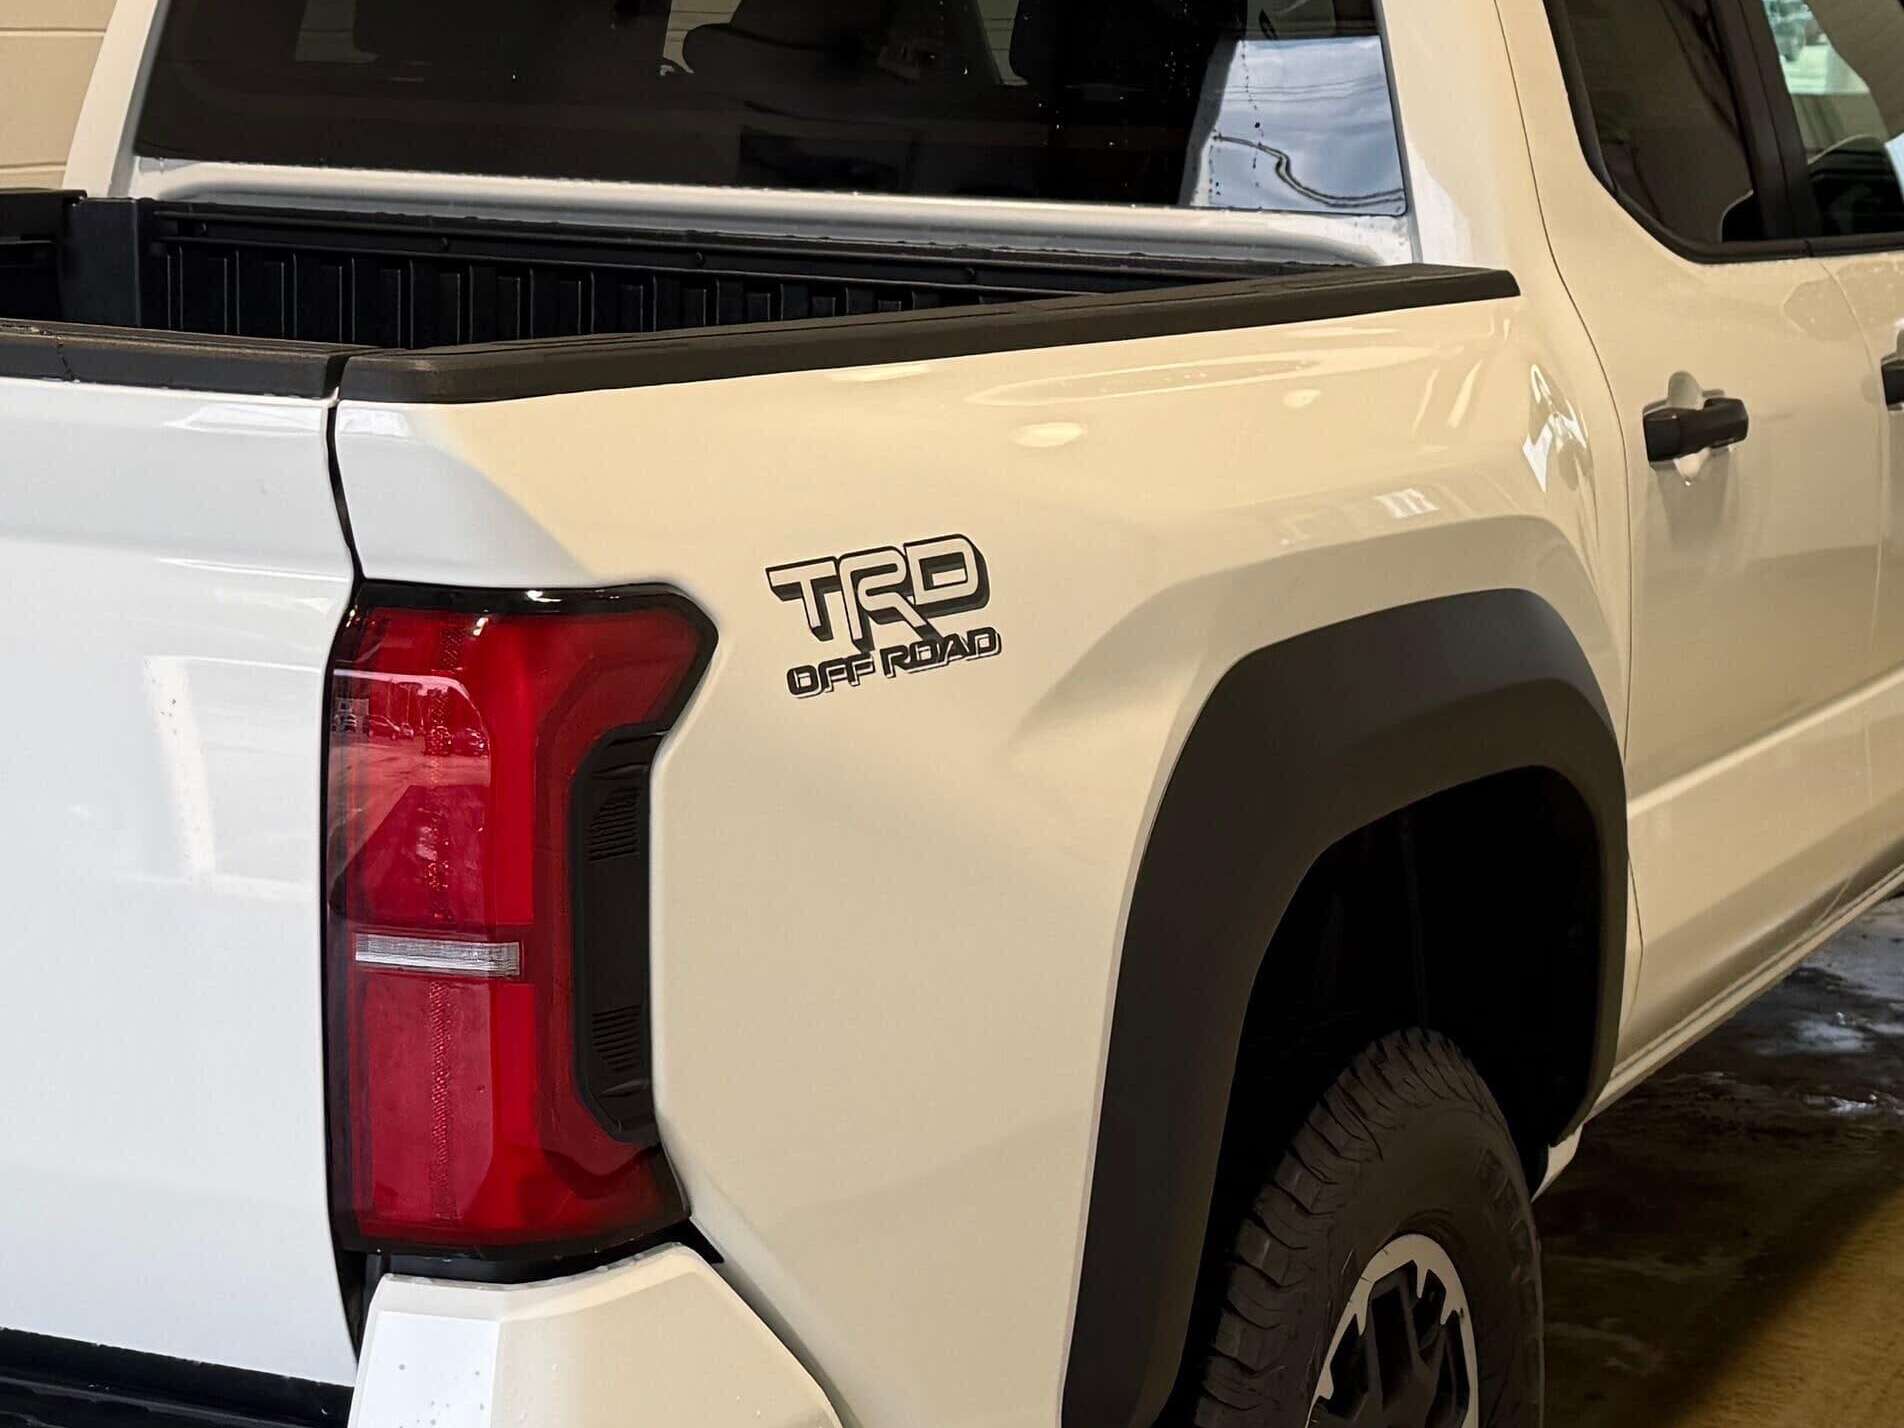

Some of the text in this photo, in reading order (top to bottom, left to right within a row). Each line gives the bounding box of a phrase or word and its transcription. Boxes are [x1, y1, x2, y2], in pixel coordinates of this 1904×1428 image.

[764, 532, 992, 654] TRD
[786, 626, 1002, 700] OFF ROAD
